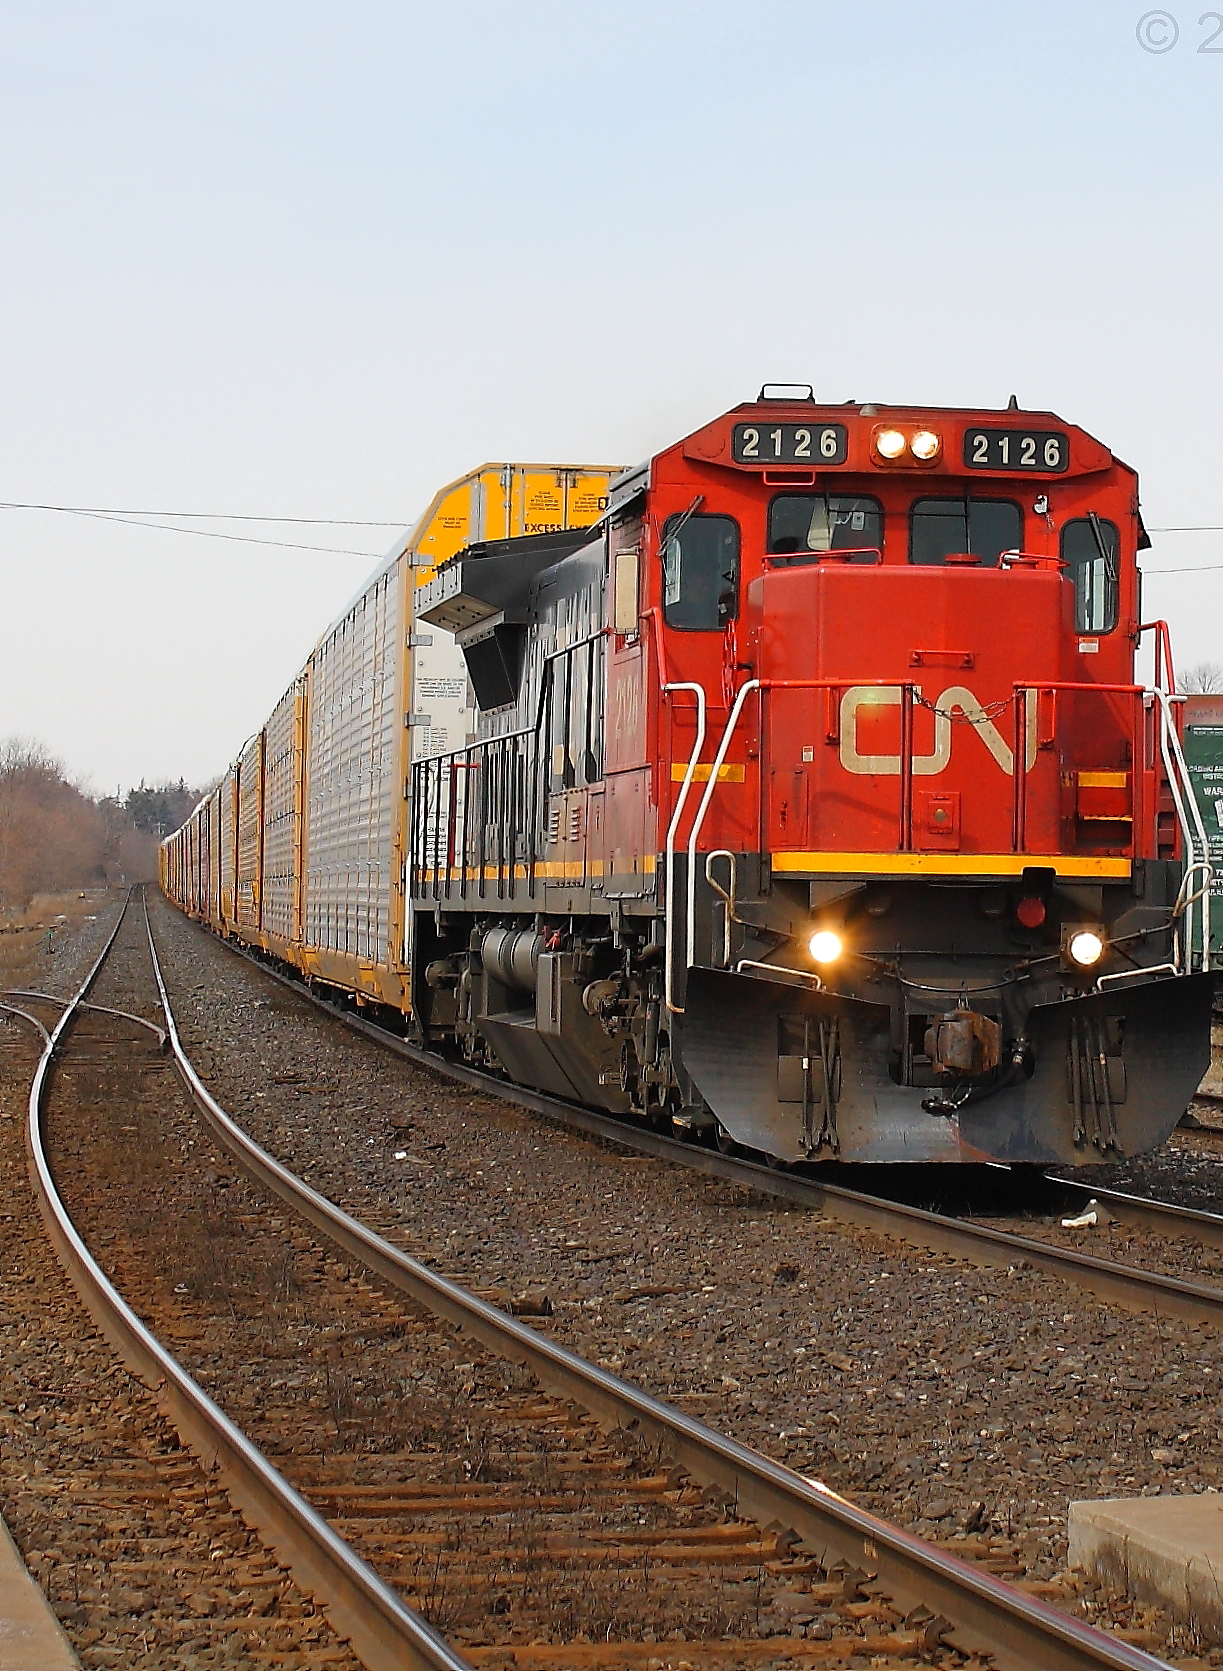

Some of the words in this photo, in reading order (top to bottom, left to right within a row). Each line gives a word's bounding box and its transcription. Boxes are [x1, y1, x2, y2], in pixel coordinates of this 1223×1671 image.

[742, 428, 837, 458] 2126
[972, 434, 1060, 467] 2126
[524, 523, 562, 533] EXCESS
[840, 685, 1038, 776] CN
